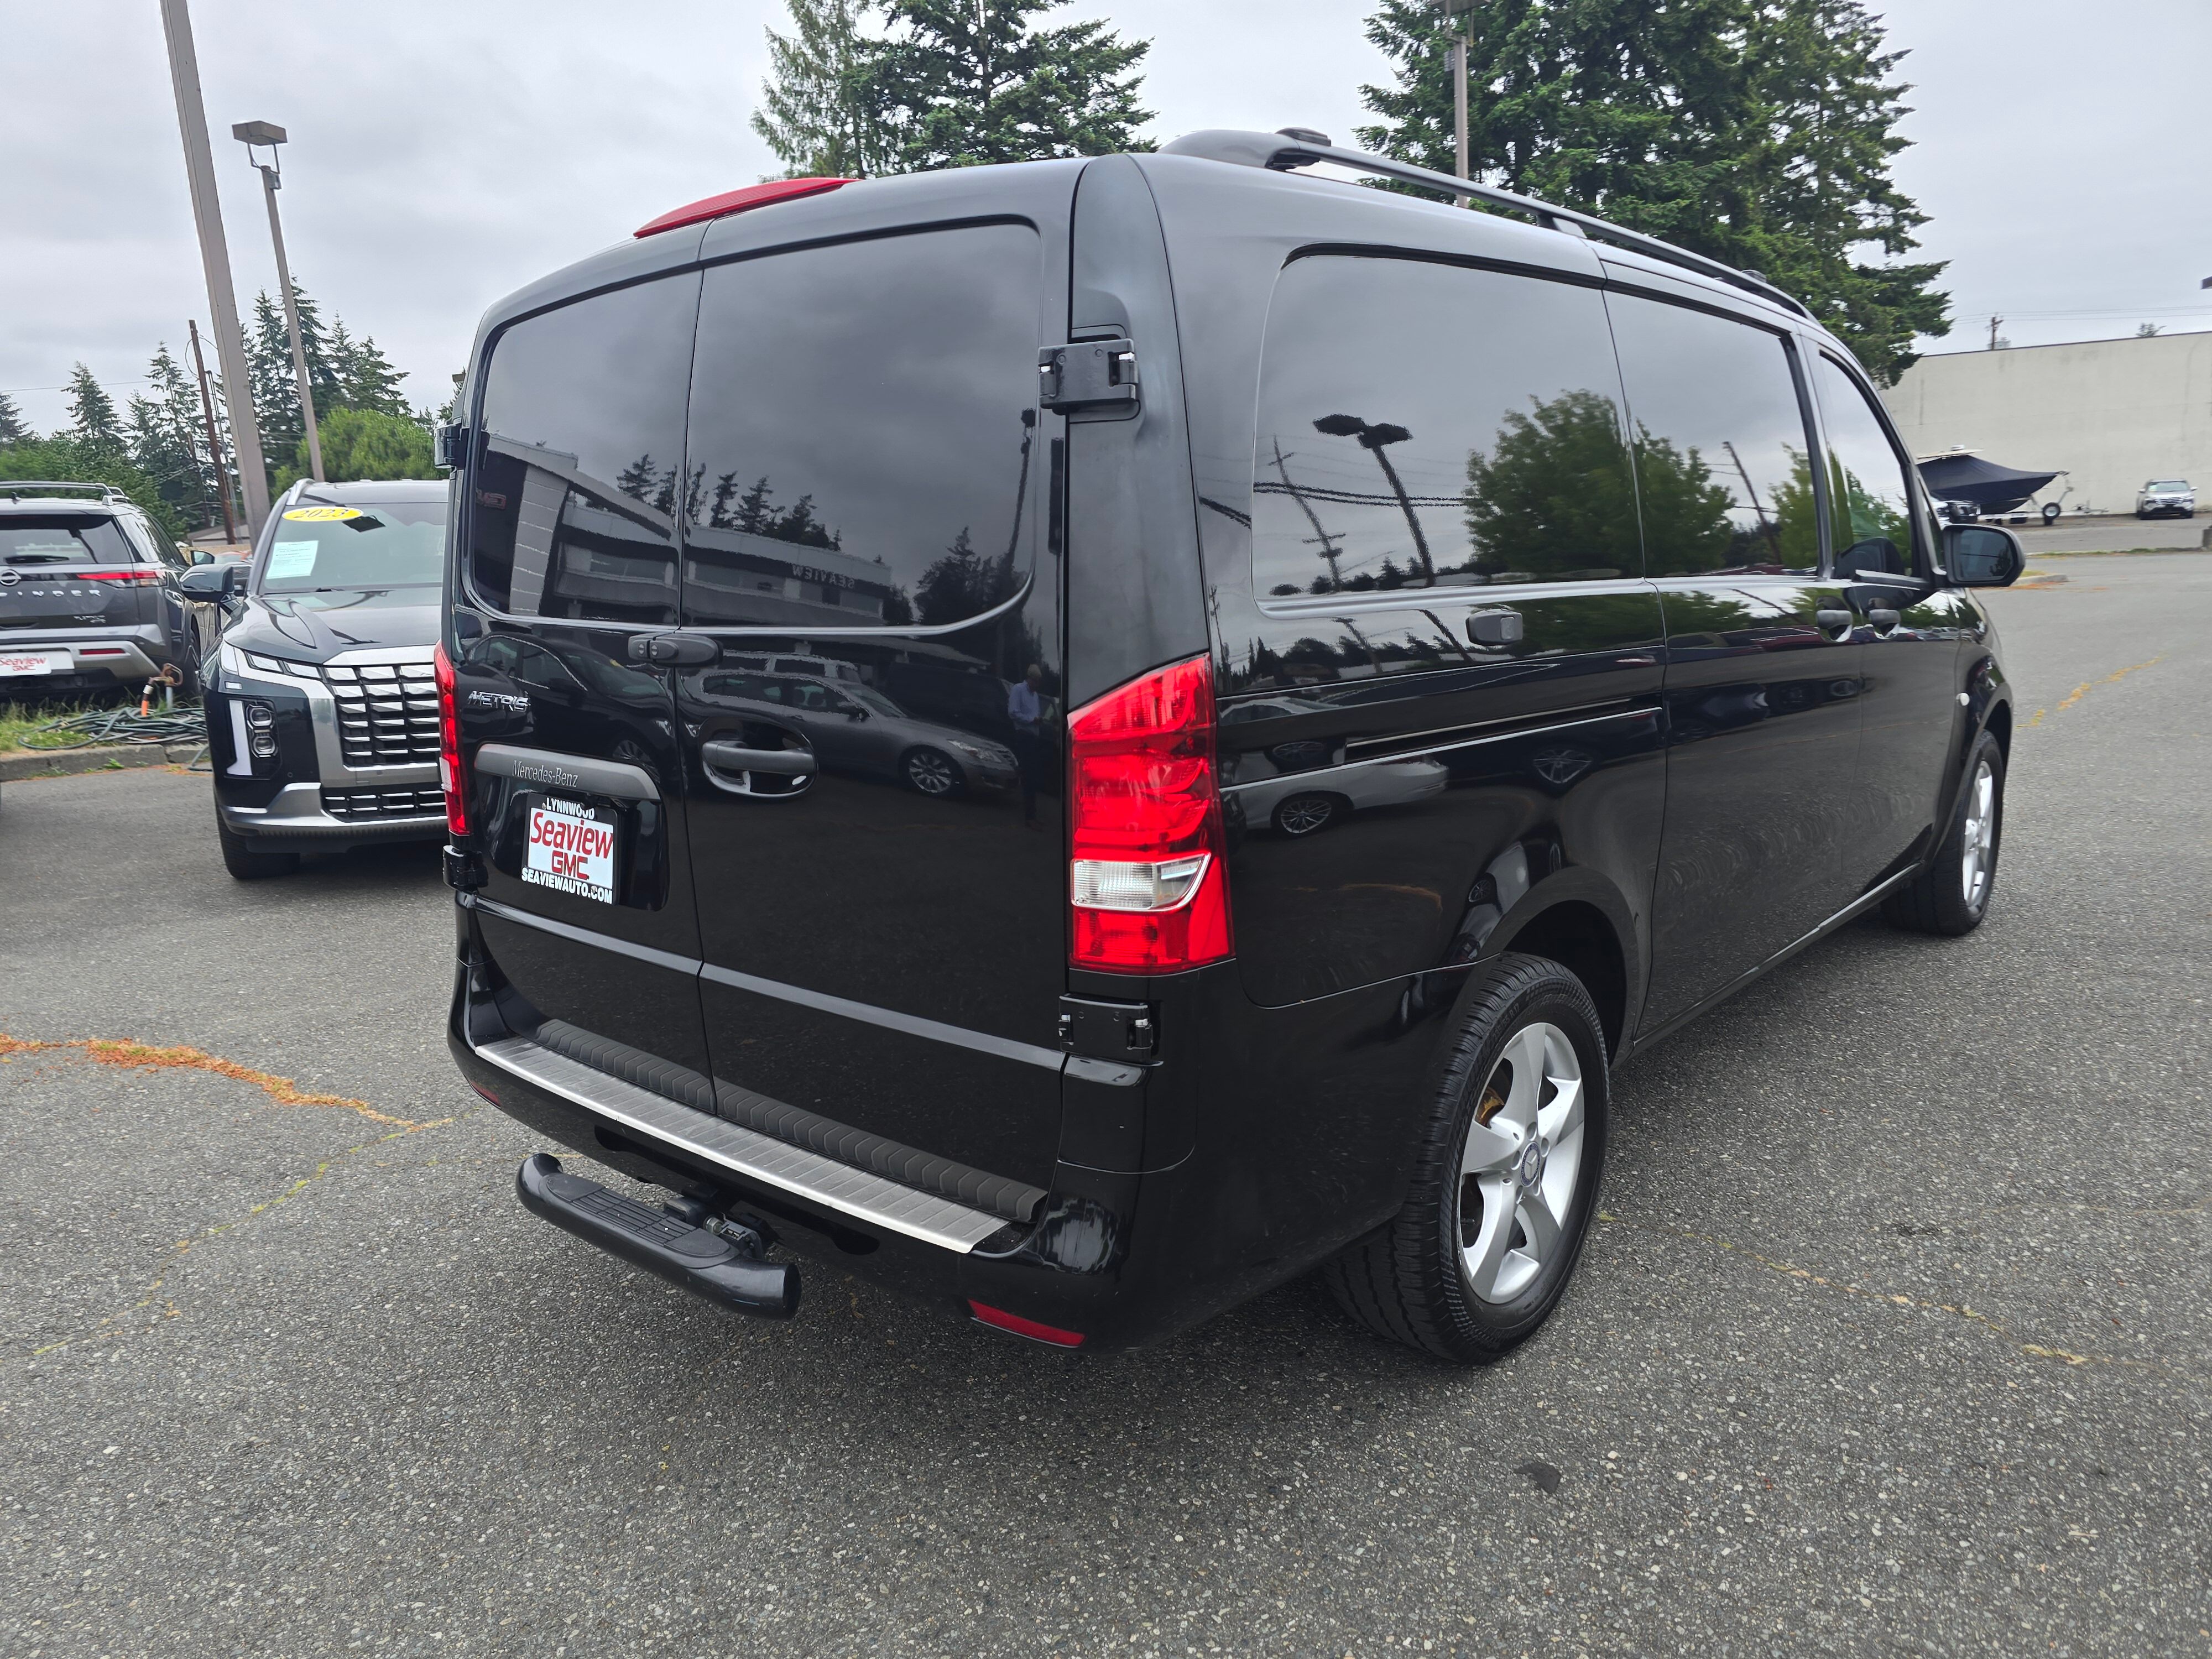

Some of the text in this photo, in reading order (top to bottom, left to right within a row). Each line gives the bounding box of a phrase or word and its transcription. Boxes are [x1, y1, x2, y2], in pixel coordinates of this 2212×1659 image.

[293, 509, 349, 519] 2023
[0, 656, 46, 666] Seaview
[468, 690, 529, 712] METRIS
[512, 760, 579, 788] Mercedes-Benz
[546, 797, 596, 820] LYNNWOOD
[530, 811, 614, 859] Seaview
[551, 849, 590, 881] GMC
[521, 867, 613, 904] SEAVIEWAUTO.COM
